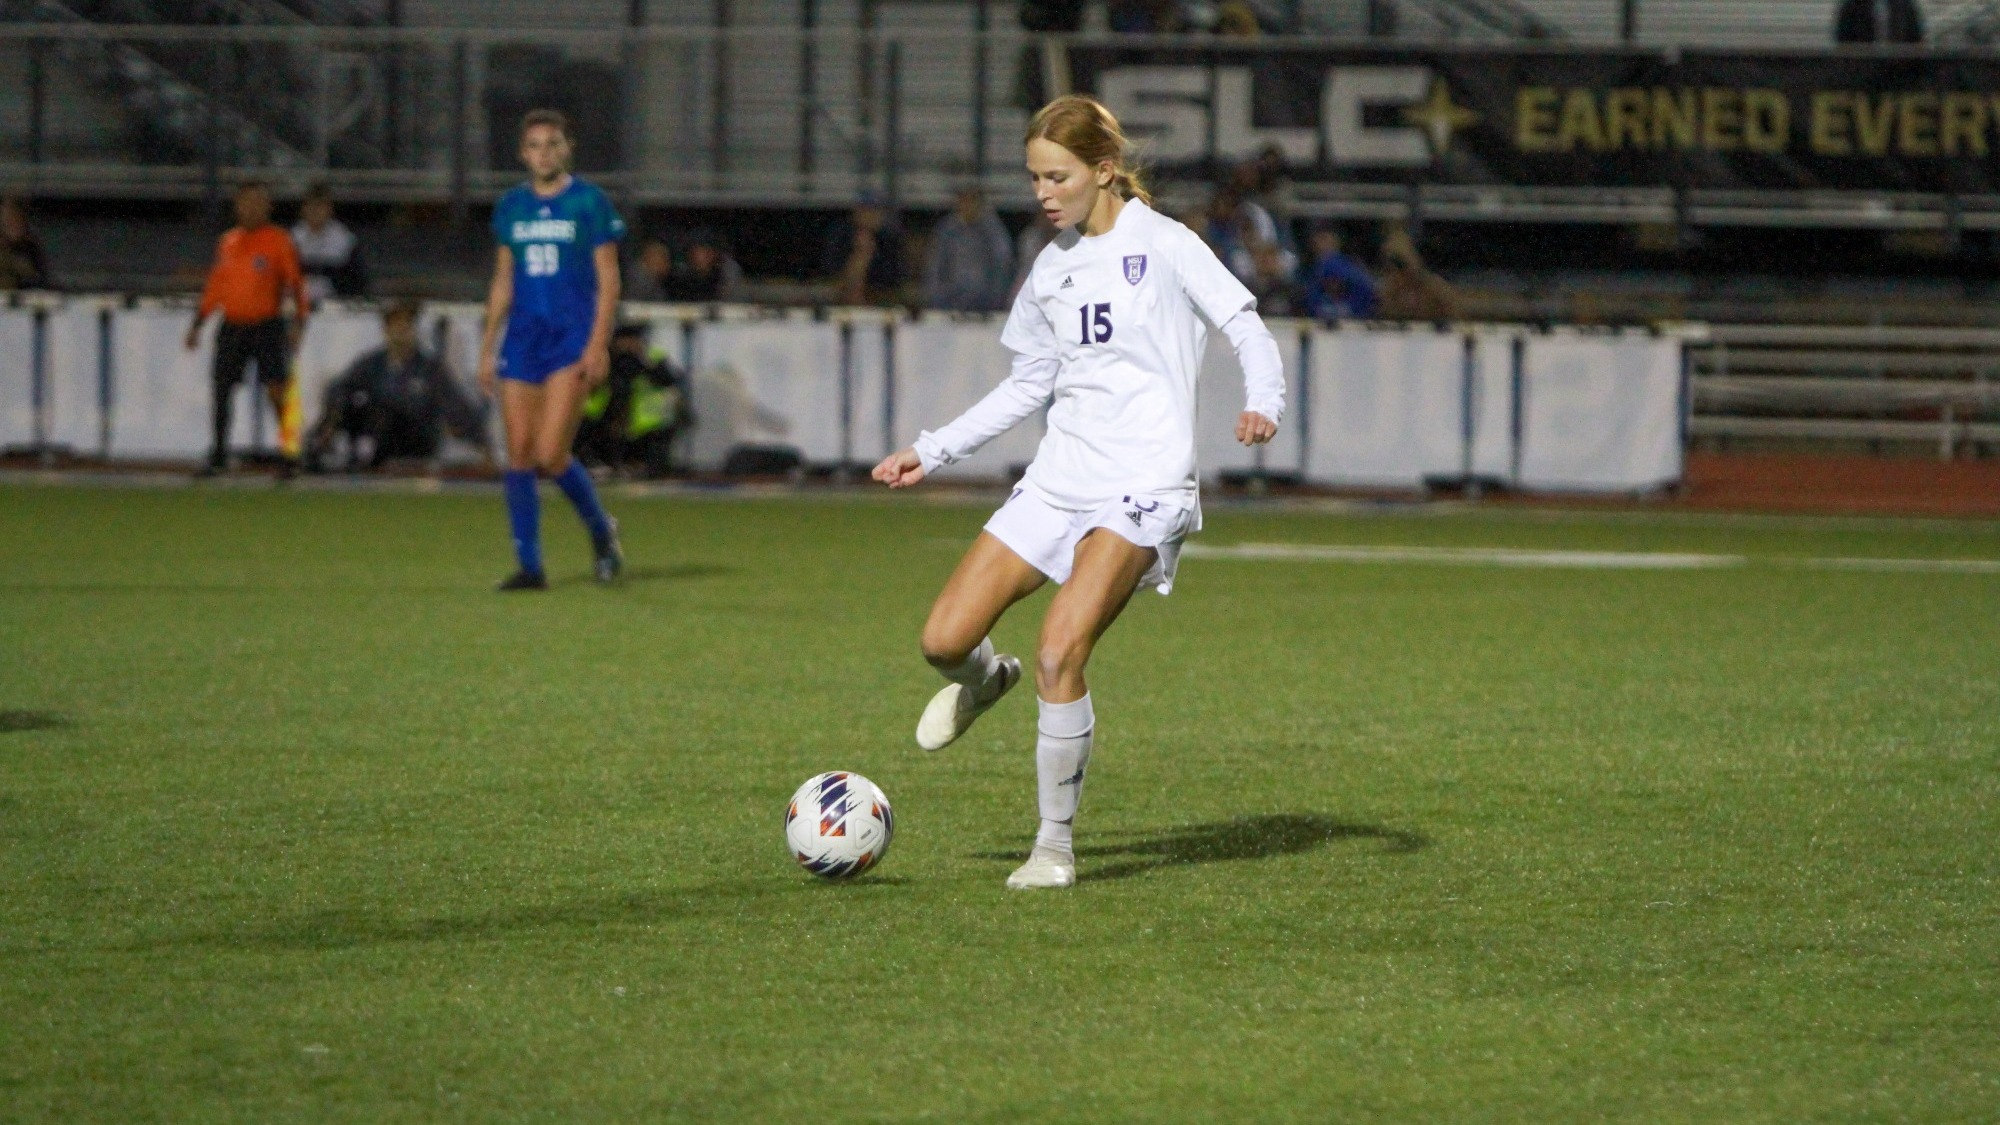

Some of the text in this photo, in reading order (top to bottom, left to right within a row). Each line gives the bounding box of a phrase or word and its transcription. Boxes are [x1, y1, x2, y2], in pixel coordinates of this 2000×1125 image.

[1099, 65, 1431, 166] SLC
[1515, 87, 1791, 151] EARNED
[1079, 302, 1113, 344] 15
